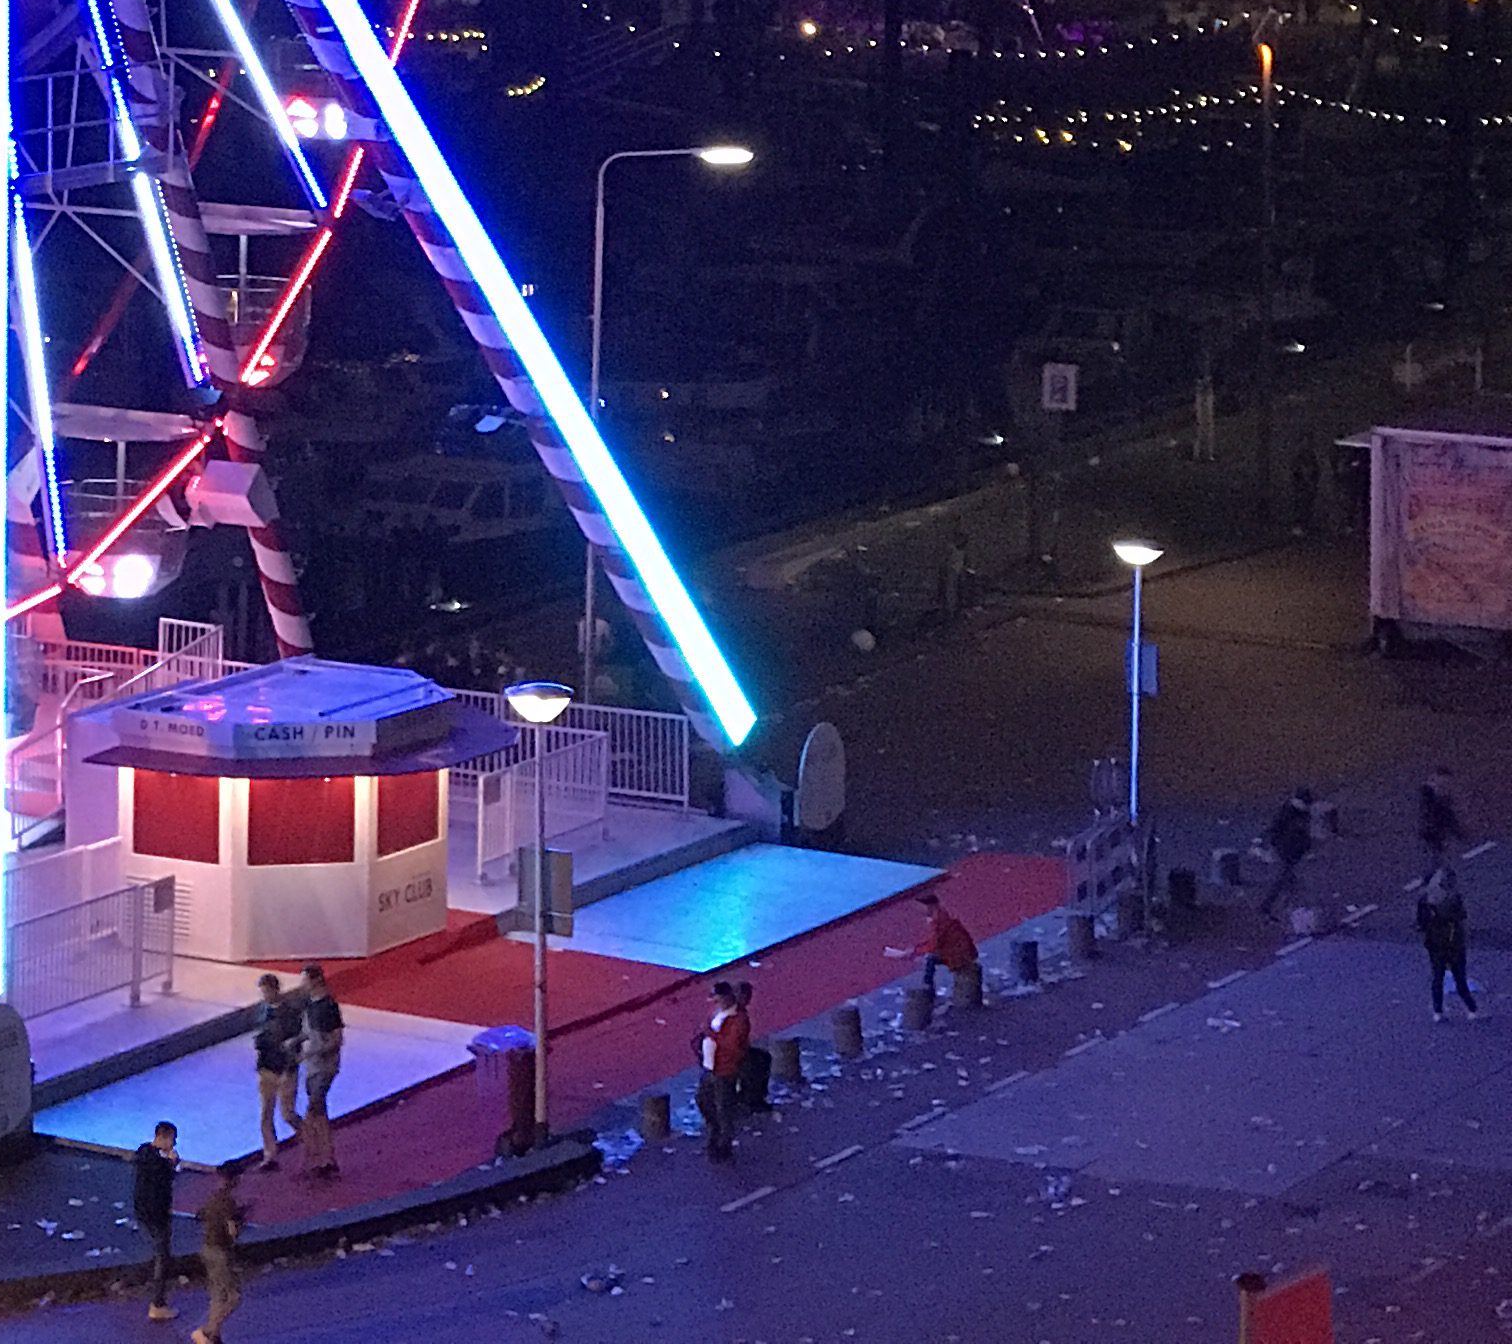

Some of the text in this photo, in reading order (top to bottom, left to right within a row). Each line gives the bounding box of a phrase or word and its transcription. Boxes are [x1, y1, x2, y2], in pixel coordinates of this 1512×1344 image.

[253, 725, 305, 742] CASH
[324, 724, 356, 740] PIN
[378, 877, 434, 913] SKY CLUB
